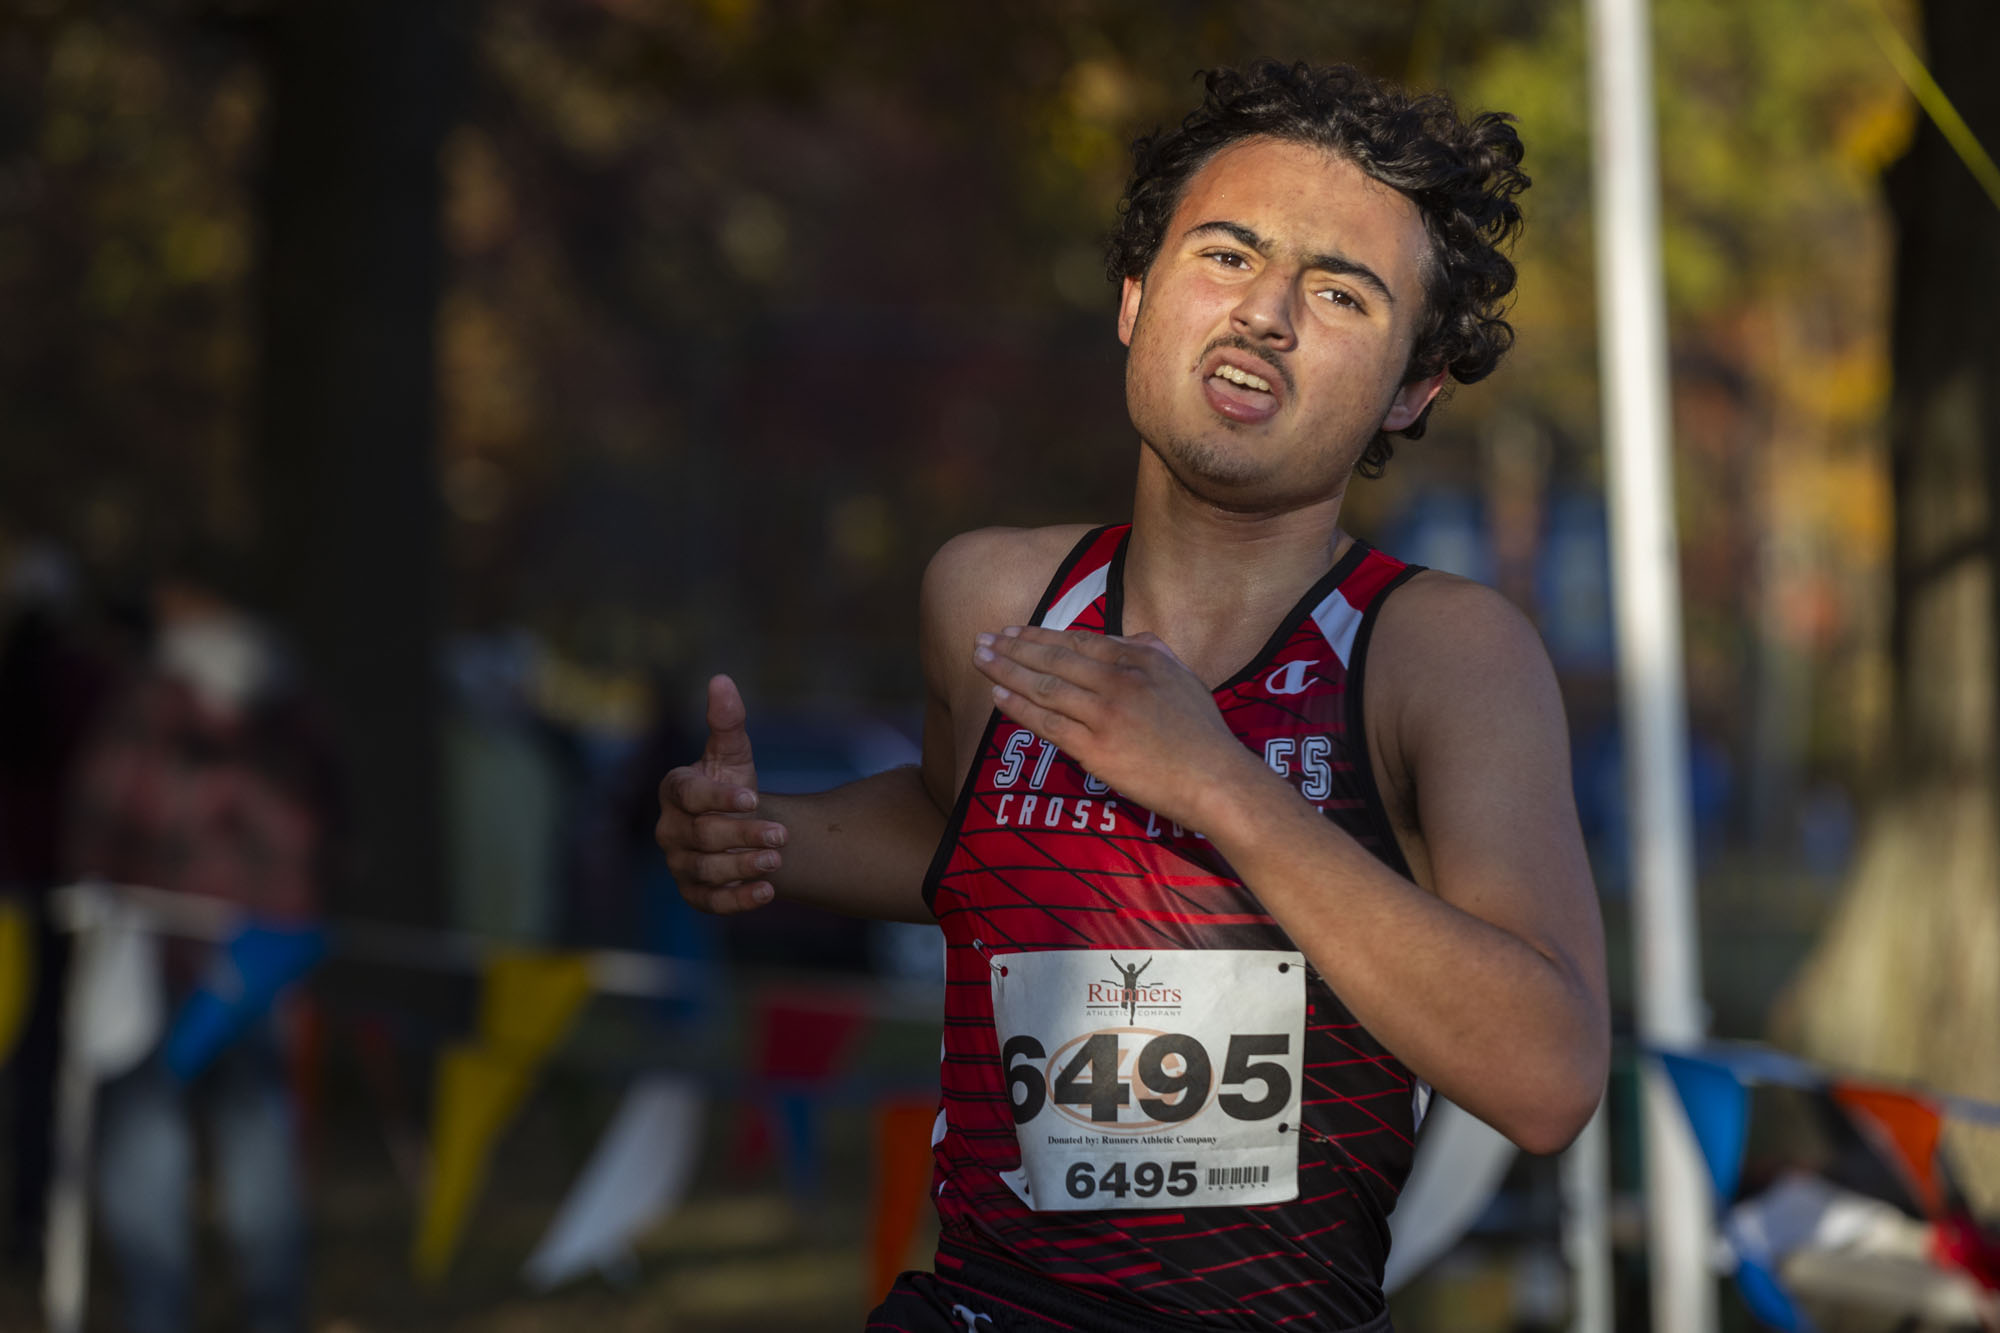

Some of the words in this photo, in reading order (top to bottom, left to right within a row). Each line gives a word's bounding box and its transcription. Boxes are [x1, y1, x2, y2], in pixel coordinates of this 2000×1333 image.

[996, 794, 1117, 832] CROSS
[1087, 983, 1182, 1003] Runners
[1086, 1009, 1129, 1017] ATHLETIC
[1138, 1009, 1182, 1017] COMPANY
[1002, 1033, 1292, 1126] 6495
[1048, 1135, 1083, 1145] Donated
[1085, 1135, 1099, 1148] by:
[1102, 1135, 1138, 1145] Runners
[1140, 1135, 1174, 1145] Athletic
[1176, 1135, 1217, 1146] Company
[1065, 1160, 1198, 1199] 6495
